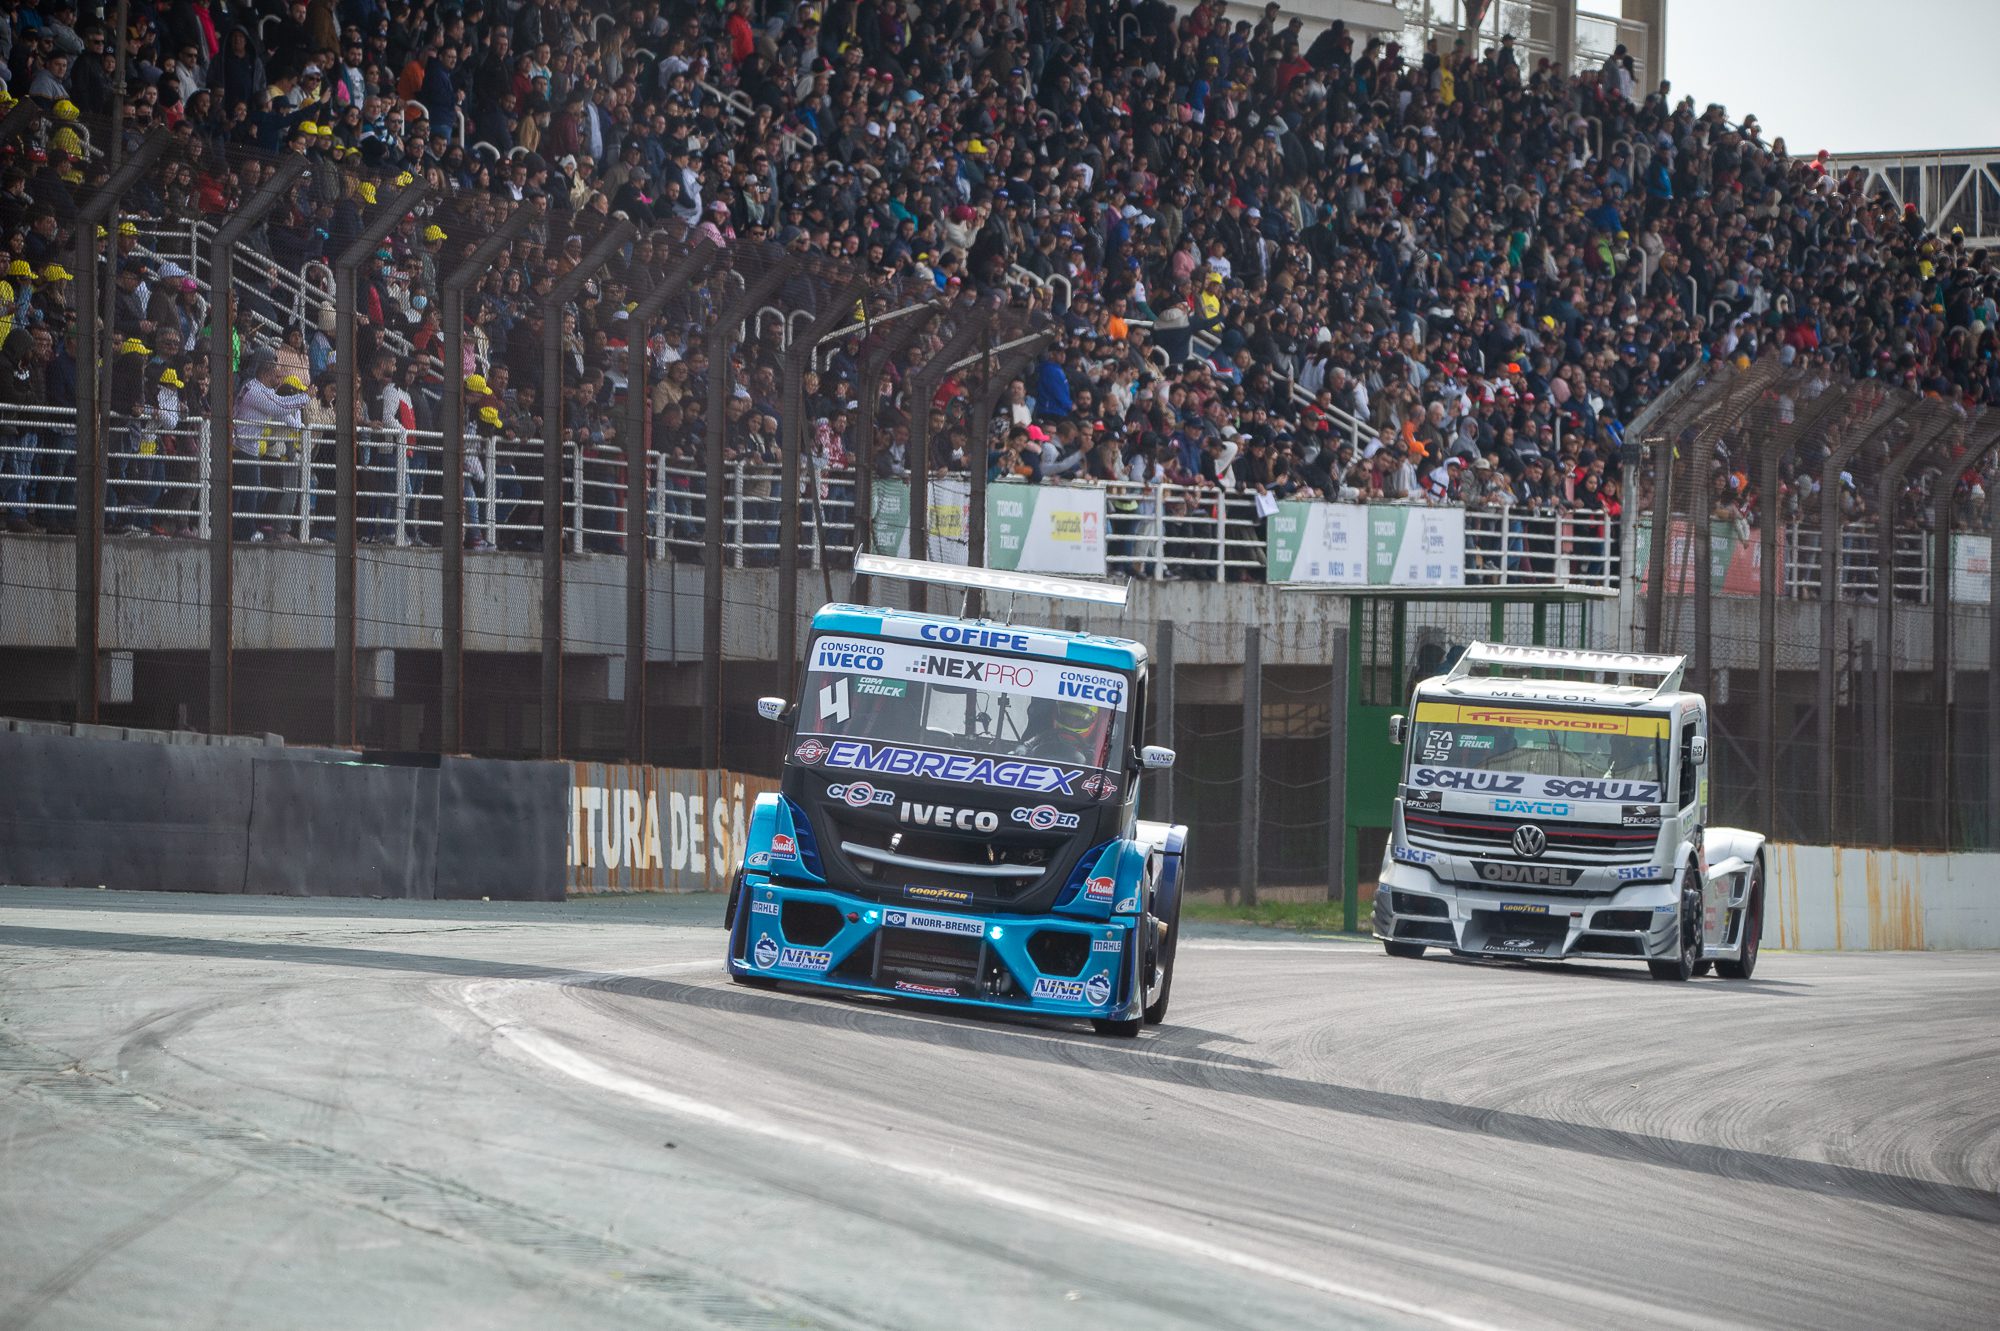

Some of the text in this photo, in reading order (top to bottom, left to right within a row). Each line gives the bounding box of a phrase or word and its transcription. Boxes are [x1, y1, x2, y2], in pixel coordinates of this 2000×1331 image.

[866, 559, 1112, 599] MERITOR
[920, 624, 1029, 651] COFIPE
[821, 642, 885, 656] CONSÓRCIO
[1485, 645, 1664, 665] MERITOR
[818, 652, 884, 671] IVECO
[927, 655, 1034, 688] NEXPRO
[857, 684, 905, 697] TRUCK
[1058, 681, 1122, 705] IVECO
[1491, 691, 1597, 703] METEOR
[819, 677, 850, 724] 4
[1467, 711, 1618, 730] THERMOID
[1459, 740, 1492, 749] TRUCK
[825, 740, 1084, 796] EMBREAGEX
[826, 781, 895, 808] CISER
[1414, 768, 1659, 802] SCHULZ SCHULZ
[900, 801, 999, 833] IVECO
[1495, 799, 1569, 816] DAYCO
[1011, 805, 1080, 830] CISER
[670, 791, 706, 873] DE
[1394, 846, 1436, 863] SKF
[1482, 862, 1572, 886] ODAPEL
[1617, 865, 1662, 880] SKF
[909, 887, 968, 900] GOODYEAR
[752, 902, 778, 914] MAHLE
[1503, 904, 1546, 914] GOODYEAR
[911, 917, 982, 934] KNORR-BREMSE
[1093, 941, 1121, 951] MAHLE
